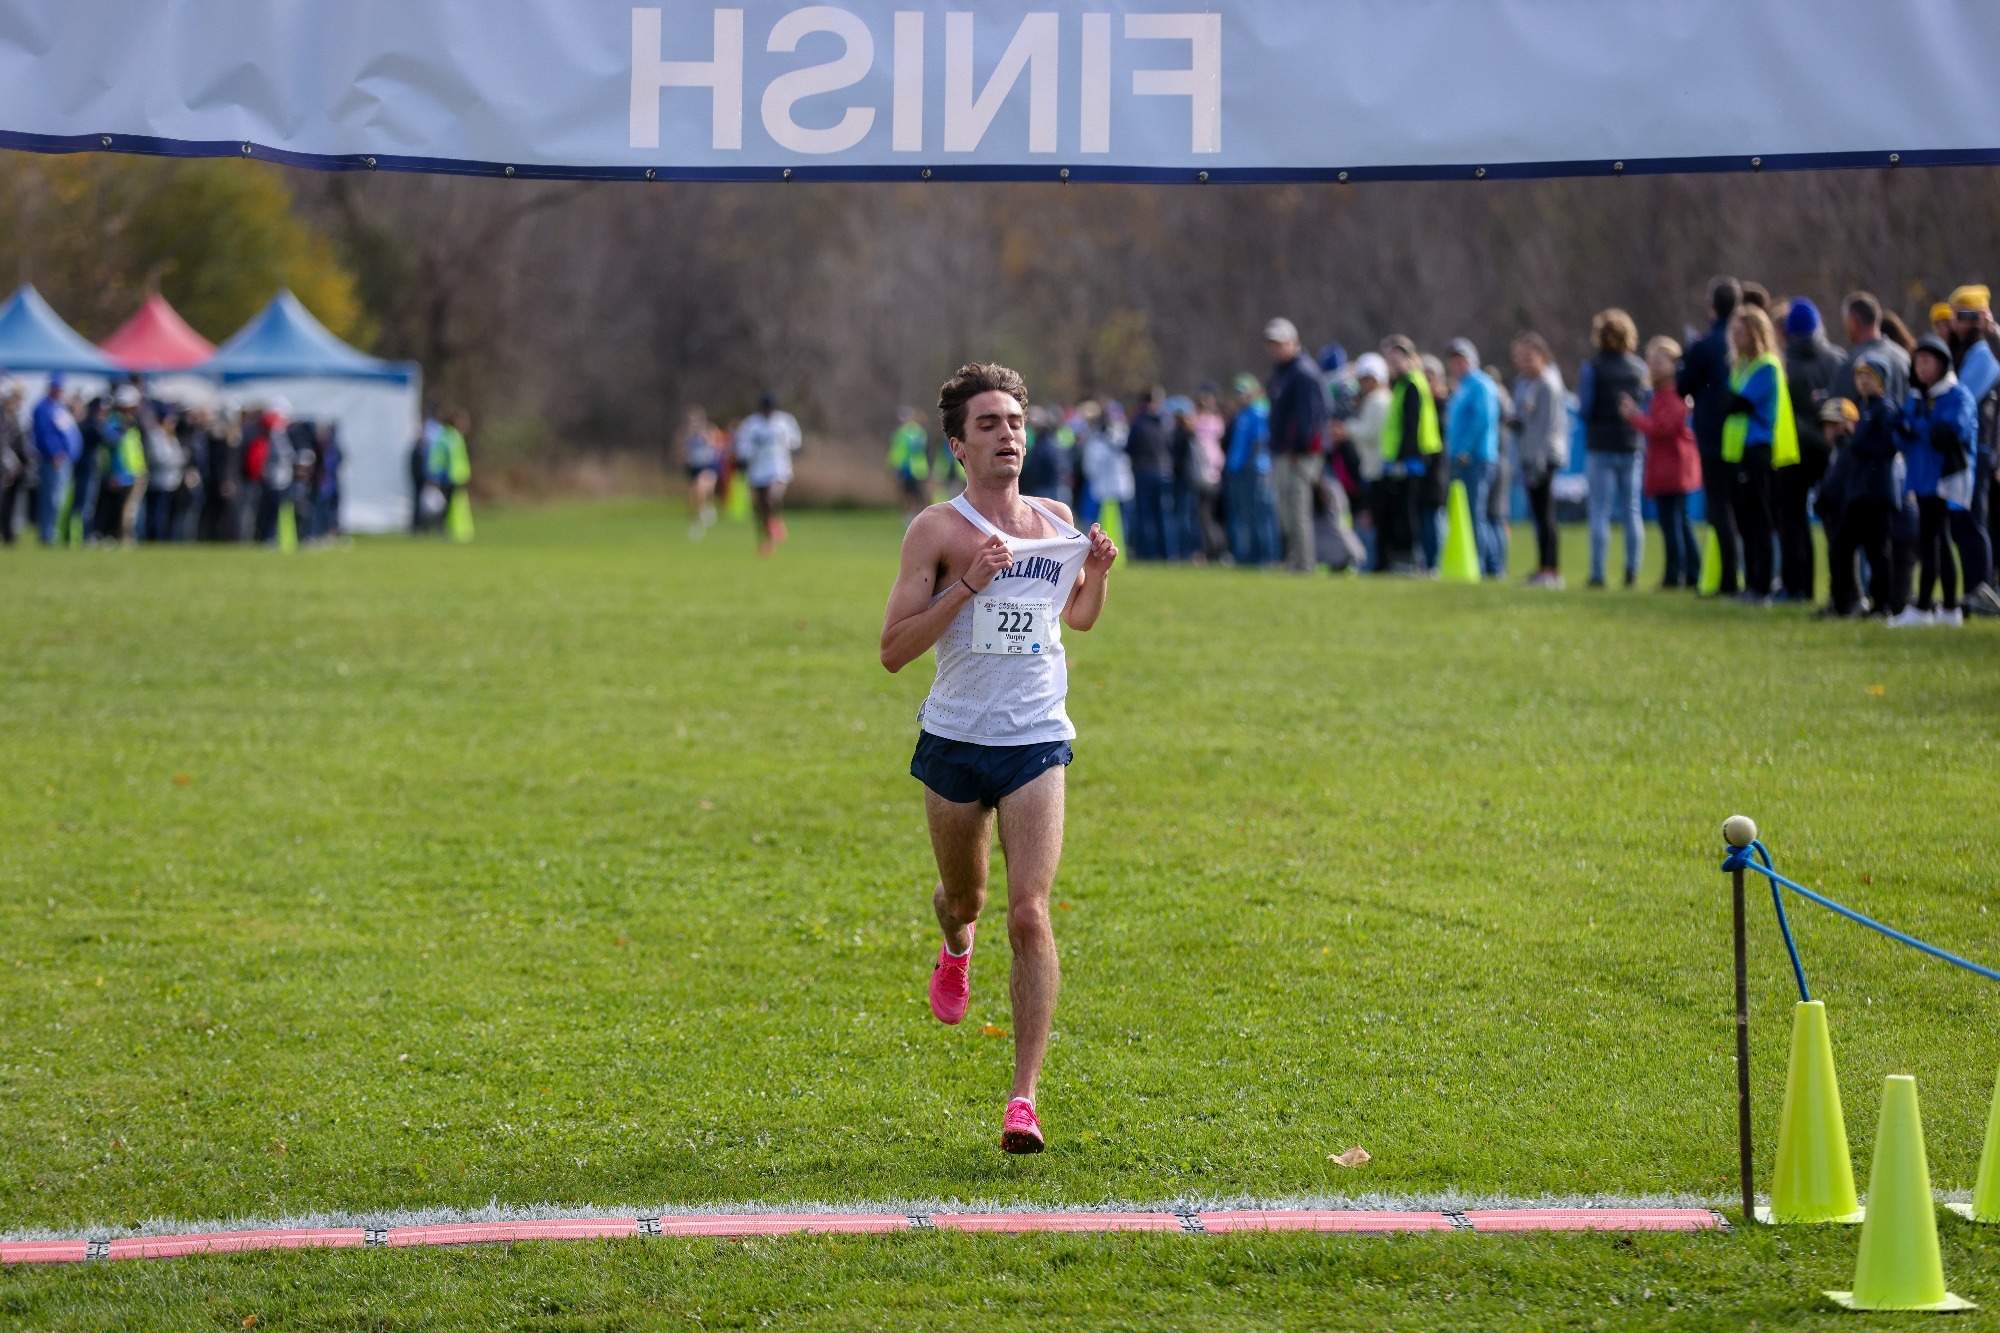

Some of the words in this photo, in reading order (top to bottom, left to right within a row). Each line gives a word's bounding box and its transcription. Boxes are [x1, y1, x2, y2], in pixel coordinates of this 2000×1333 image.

[994, 557, 1063, 586] ILLANOVA
[997, 611, 1033, 632] 222
[1005, 633, 1026, 642] Murphy
